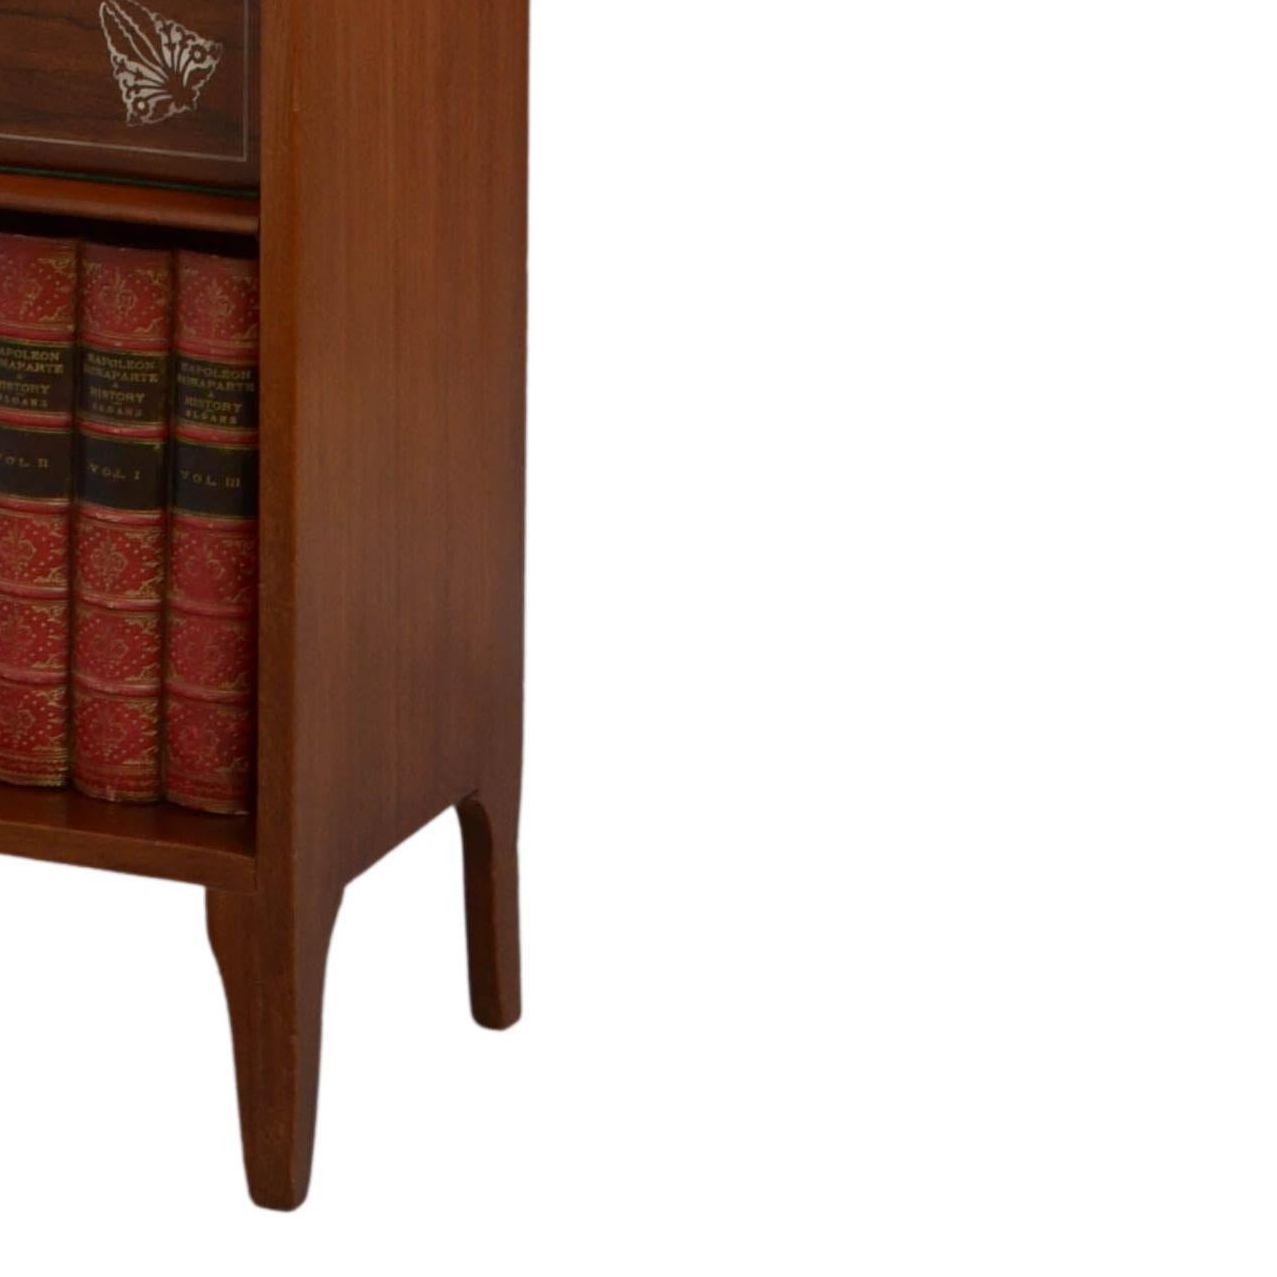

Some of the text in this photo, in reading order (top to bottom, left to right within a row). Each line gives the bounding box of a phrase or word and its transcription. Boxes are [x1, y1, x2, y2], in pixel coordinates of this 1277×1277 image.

[87, 353, 156, 370] NAPOLEON
[89, 386, 146, 403] HISTORY
[185, 396, 243, 413] HISTORY
